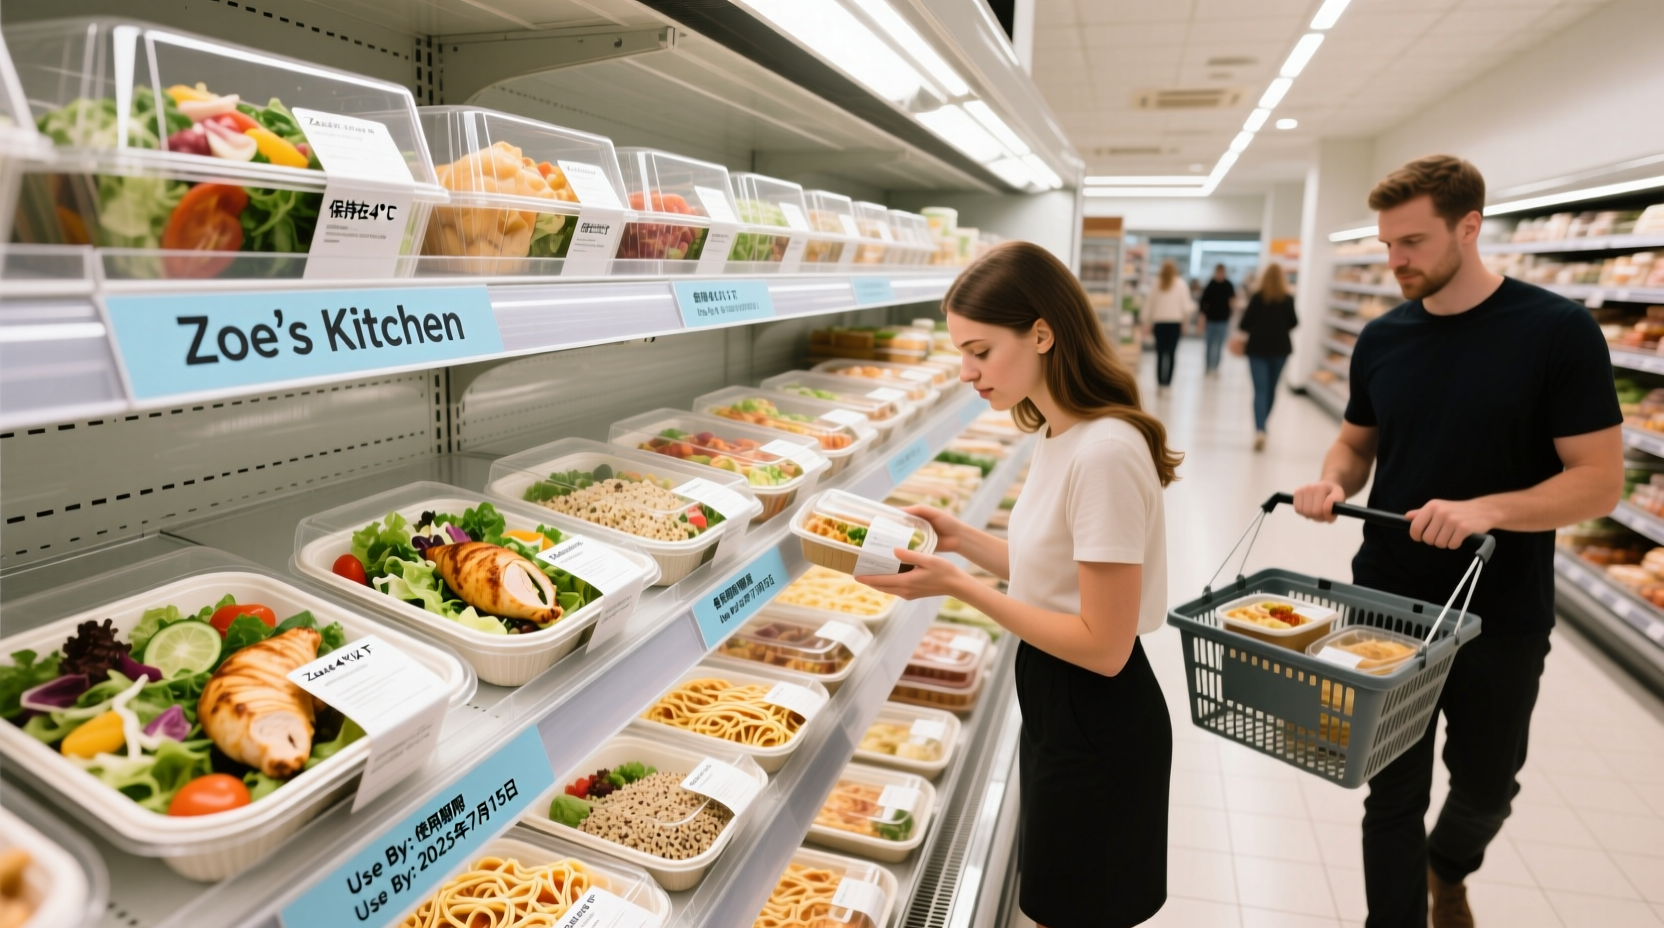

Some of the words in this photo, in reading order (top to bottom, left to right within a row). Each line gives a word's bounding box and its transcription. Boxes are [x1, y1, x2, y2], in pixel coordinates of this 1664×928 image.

[177, 309, 313, 365] Zoe's
[321, 304, 465, 352] Kitchen
[347, 861, 383, 894] Use
[385, 837, 415, 865] By:
[354, 891, 388, 921] Use
[390, 866, 417, 894] By:
[417, 778, 519, 872] 2025年7月15日
